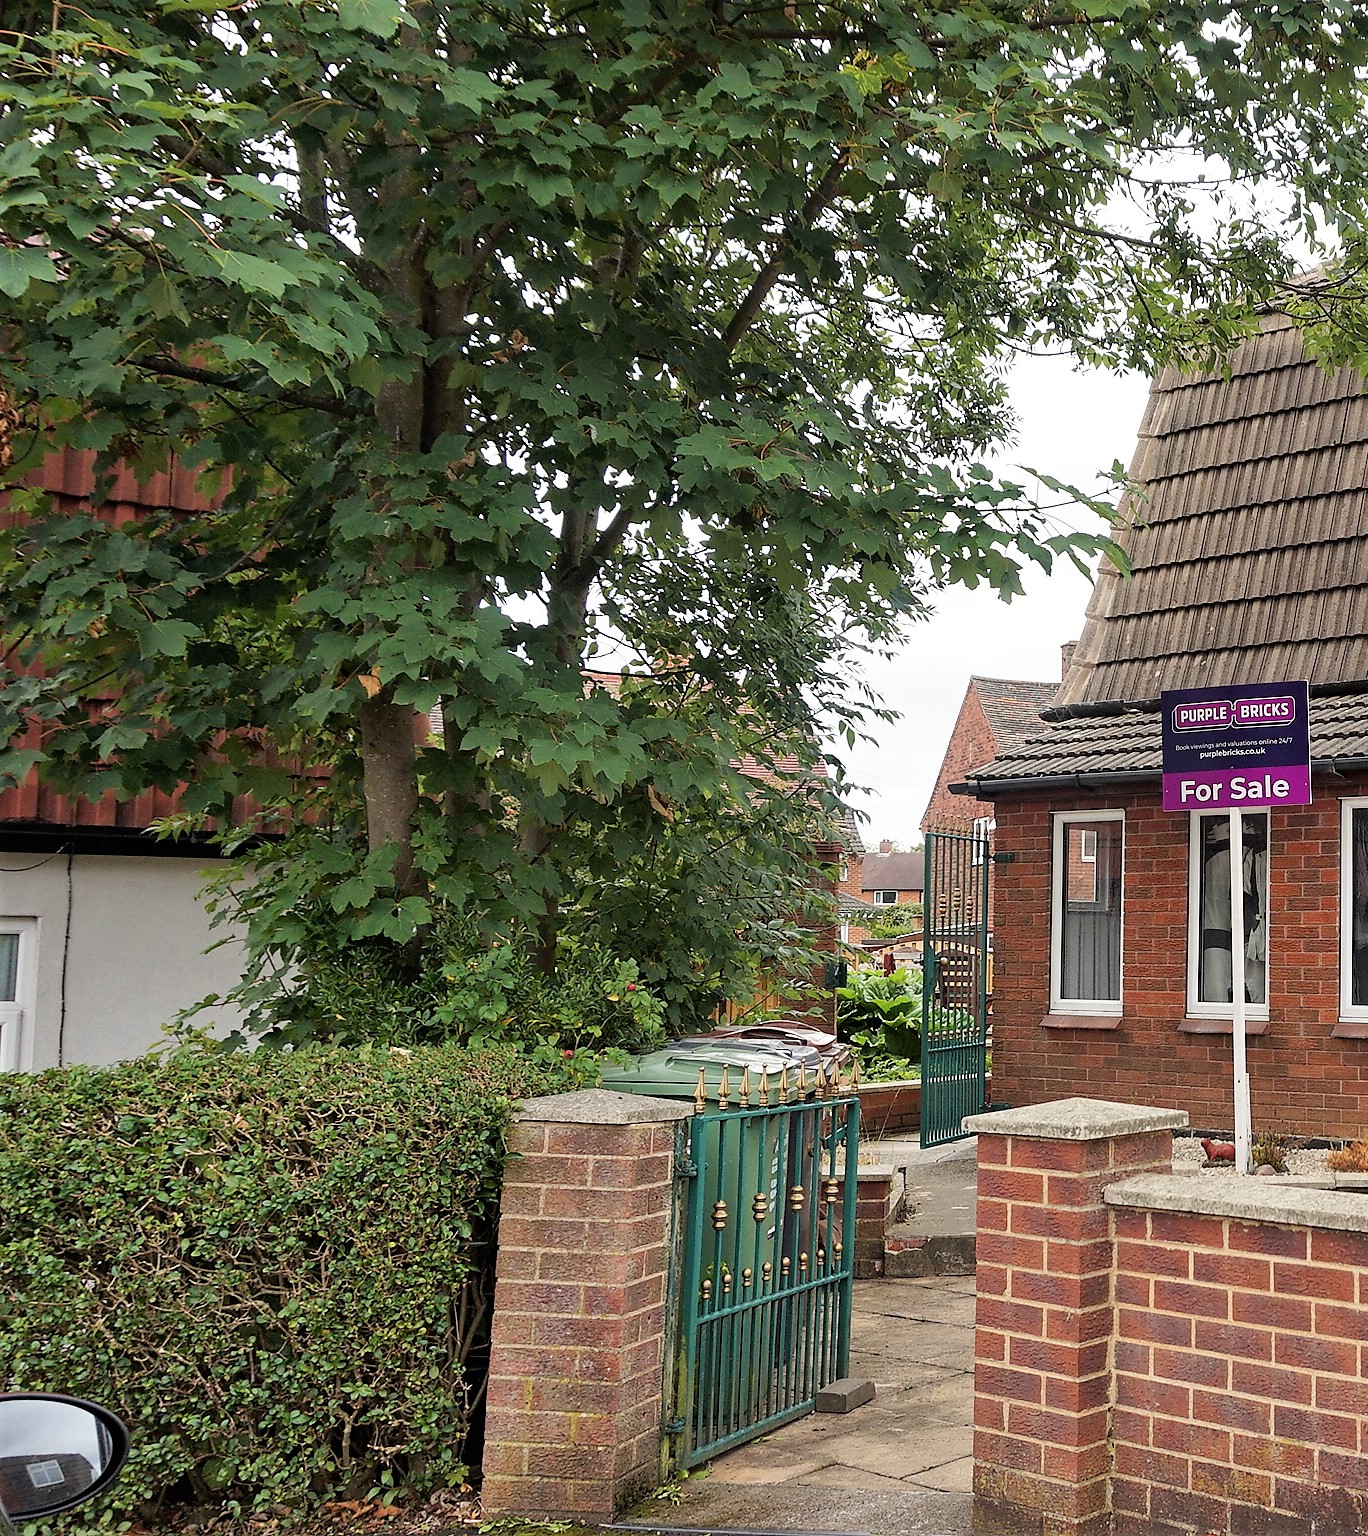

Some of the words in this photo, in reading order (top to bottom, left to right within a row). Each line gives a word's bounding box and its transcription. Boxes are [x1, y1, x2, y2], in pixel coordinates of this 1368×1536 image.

[1180, 706, 1228, 723] PURPLE
[1240, 702, 1289, 718] BRICKS
[1175, 744, 1190, 752] Book
[1190, 742, 1215, 751] viewings
[1227, 739, 1258, 748] valuations
[1258, 738, 1278, 746] online
[1278, 737, 1293, 745] 24/7
[1200, 747, 1266, 759] purplebricks.co.uk
[1180, 780, 1223, 803] For
[1229, 774, 1290, 800] Sale
